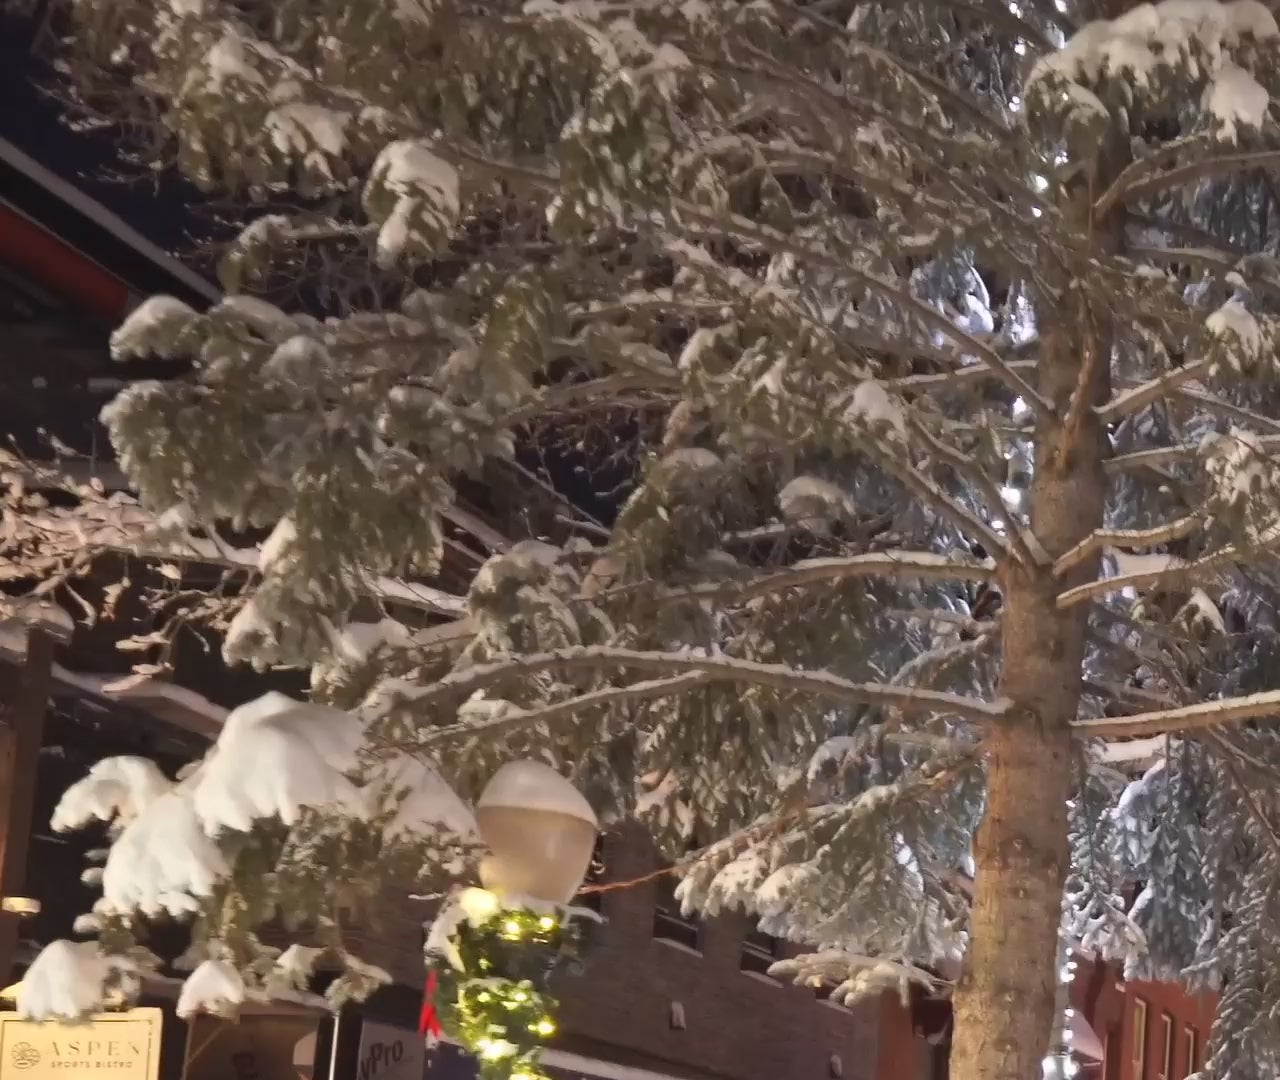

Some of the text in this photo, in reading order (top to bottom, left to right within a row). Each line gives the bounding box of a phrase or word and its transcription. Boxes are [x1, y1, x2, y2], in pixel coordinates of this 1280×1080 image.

[49, 1040, 141, 1057] ASPEN
[50, 1061, 134, 1069] SPORTS BISTRO
